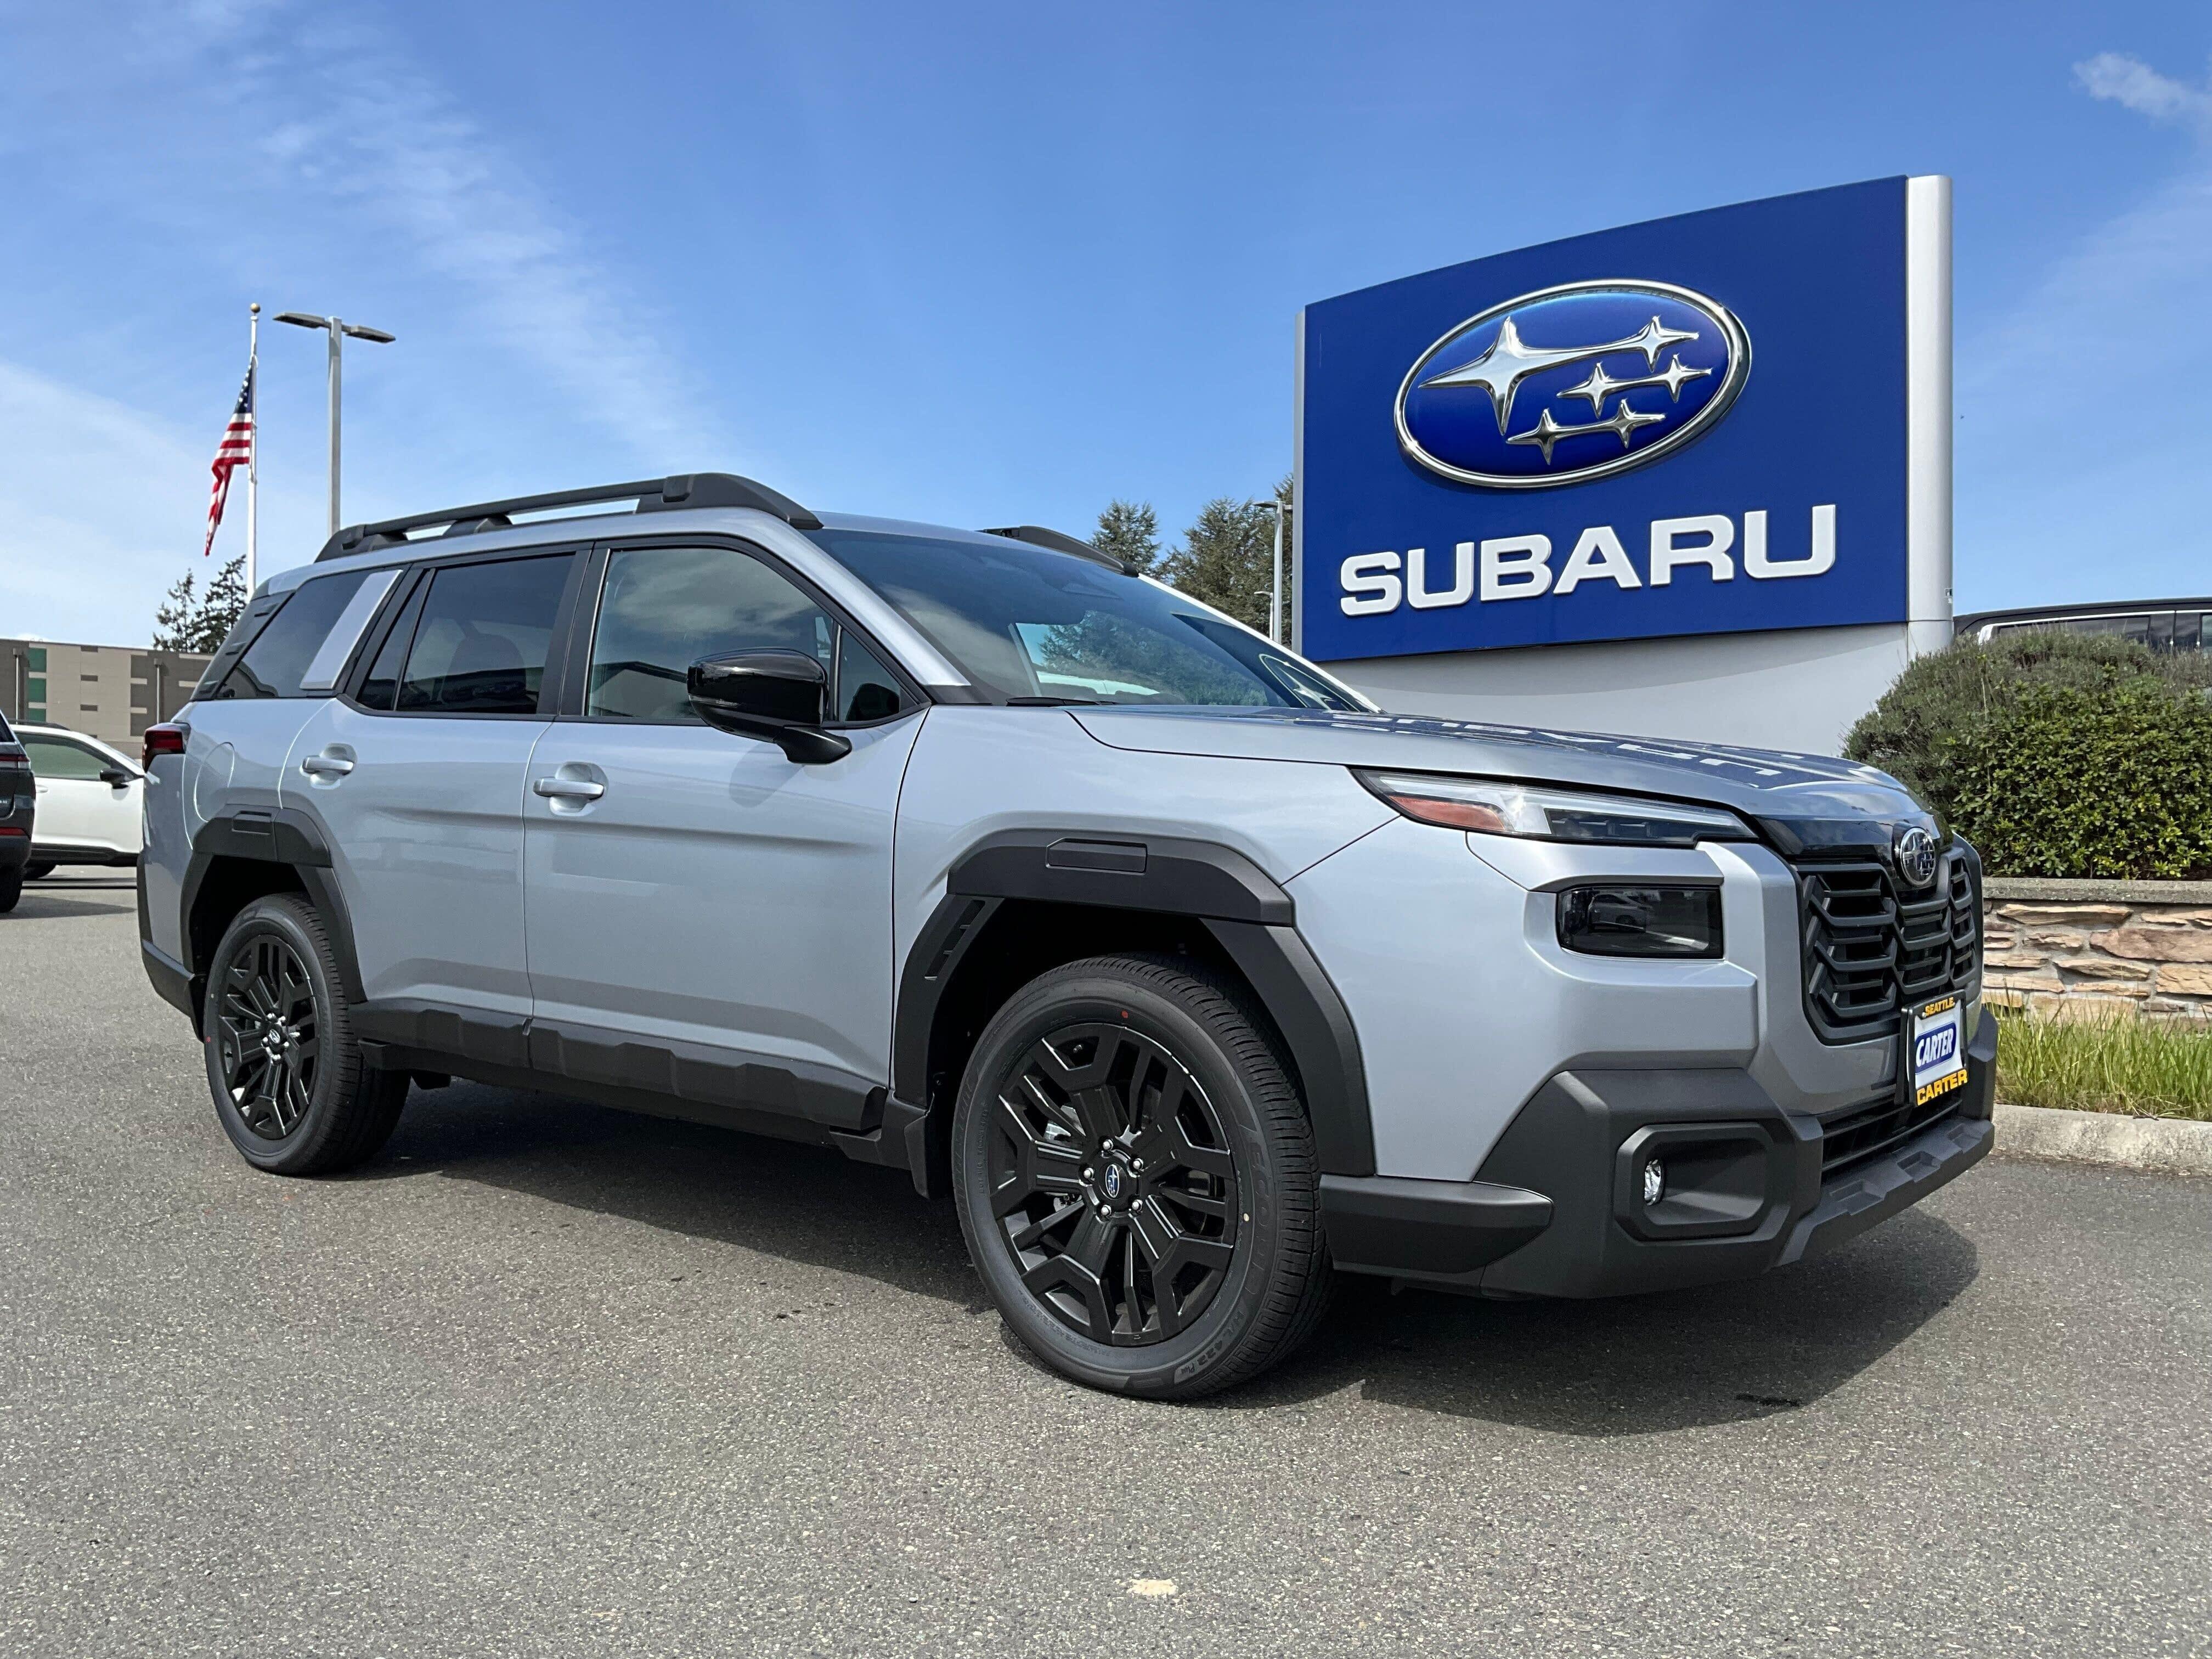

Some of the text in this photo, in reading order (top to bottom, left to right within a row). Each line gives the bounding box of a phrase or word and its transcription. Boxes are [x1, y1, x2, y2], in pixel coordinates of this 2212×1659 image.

[1340, 504, 1836, 616] SUBARU
[1925, 996, 1954, 1016] SEATTLE
[1916, 1028, 1954, 1067] CARTER
[1917, 1069, 1968, 1106] CARTER
